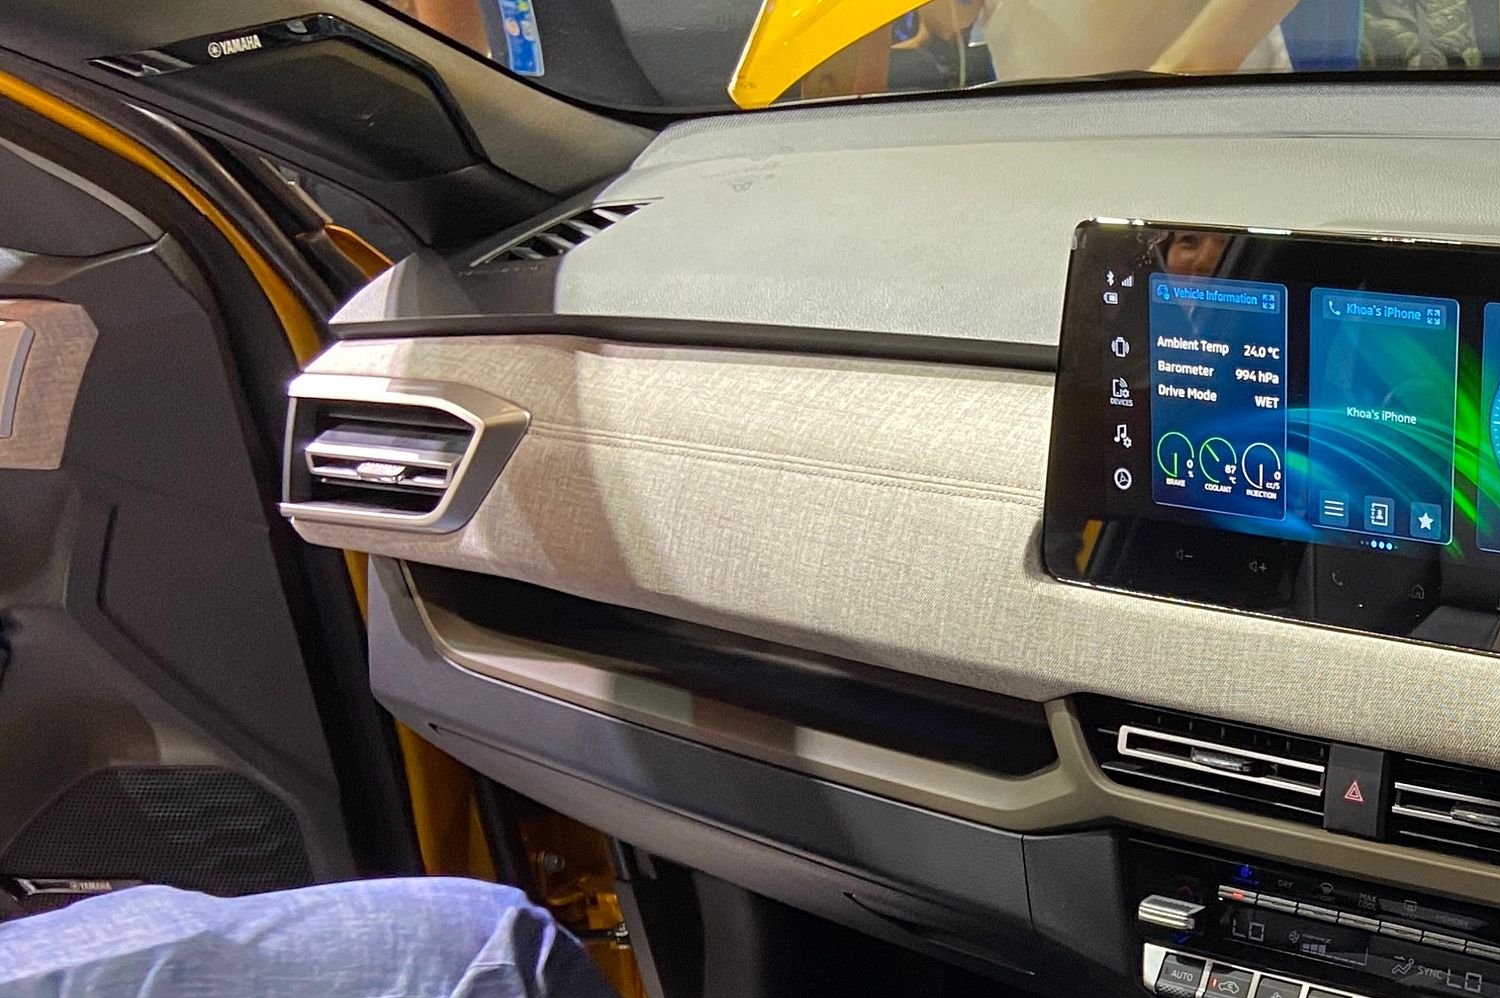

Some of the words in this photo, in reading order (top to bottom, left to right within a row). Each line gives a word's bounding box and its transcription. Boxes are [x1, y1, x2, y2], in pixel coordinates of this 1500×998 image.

[220, 34, 262, 55] YAMAHA
[1174, 287, 1204, 300] Vehicle
[1206, 290, 1257, 305] Information
[1346, 303, 1382, 317] Khoa's
[1384, 305, 1421, 320] iPhone
[1157, 336, 1199, 351] Ambient
[1200, 340, 1229, 356] Temp
[1243, 345, 1266, 358] 24.0
[1157, 360, 1214, 377] Barometer
[1235, 368, 1256, 382] 994
[1258, 370, 1279, 384] hPa
[1158, 384, 1185, 398] Drive
[1187, 387, 1217, 401] Mode
[1110, 397, 1133, 407] DEVICES
[1254, 395, 1280, 409] WET
[1346, 406, 1379, 420] Khoa's
[1382, 410, 1416, 424] iPhone
[1186, 459, 1194, 469] 0
[1166, 478, 1186, 487] BRAKE
[1274, 471, 1281, 480] 0
[1204, 483, 1232, 493] COOLANT
[1246, 489, 1277, 499] INJECTION
[1170, 969, 1193, 982] AUTO
[1417, 965, 1443, 980] SYNC
